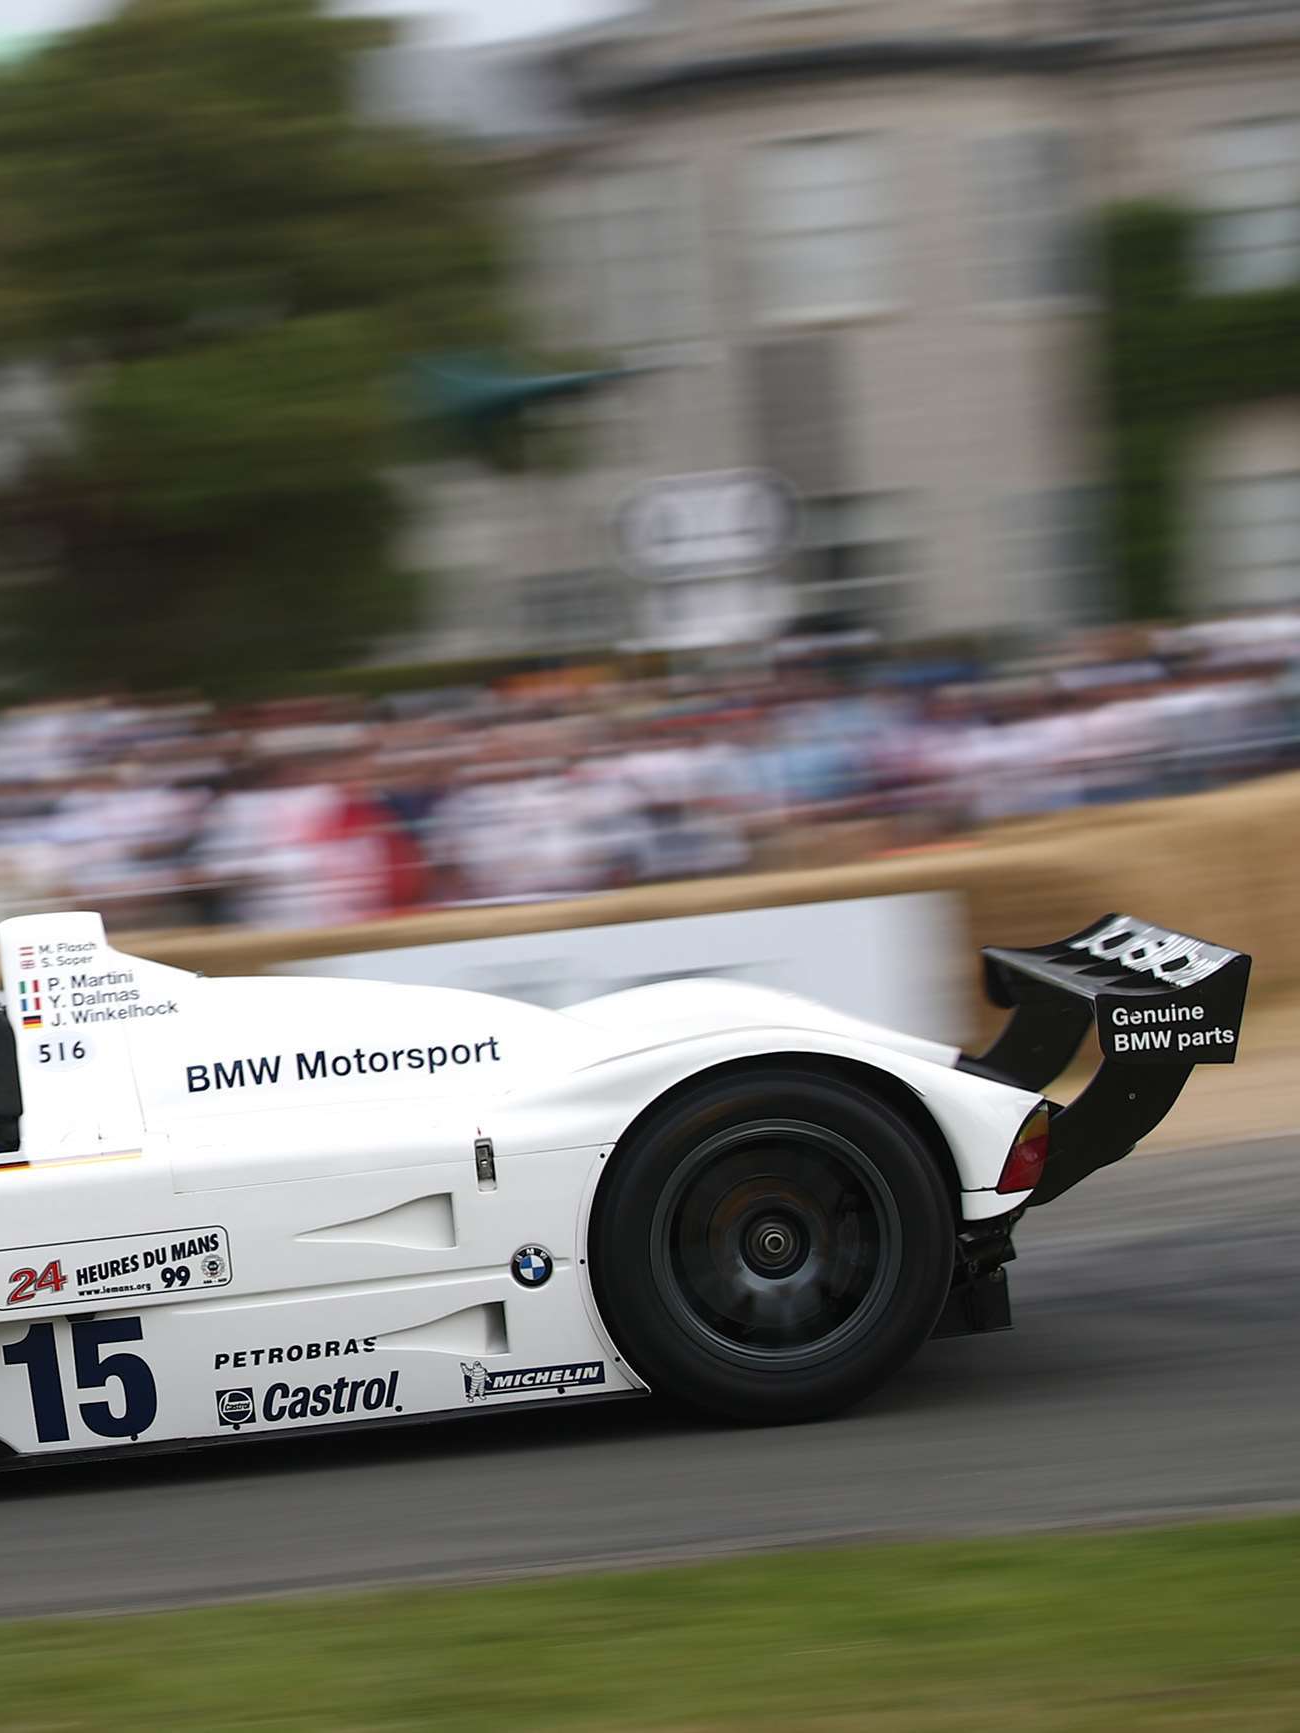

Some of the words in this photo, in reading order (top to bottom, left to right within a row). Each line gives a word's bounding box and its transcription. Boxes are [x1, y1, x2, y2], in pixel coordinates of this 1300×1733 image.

[41, 957, 54, 968] S.
[48, 977, 66, 991] P.
[71, 969, 134, 989] Martini
[48, 995, 66, 1009] Y.
[72, 987, 140, 1007] Dalmas
[51, 1013, 67, 1027] J.
[72, 1000, 178, 1024] Winkelhock
[1111, 1003, 1204, 1026] Genuine
[1113, 1030, 1172, 1052] BMW
[1178, 1027, 1235, 1051] parts
[38, 1041, 86, 1063] 516
[186, 1055, 282, 1093] BMW
[296, 1036, 500, 1080] Motorsport
[6, 1259, 68, 1306] 24
[76, 1254, 139, 1286] HEURES
[143, 1246, 167, 1269] DU
[171, 1233, 218, 1261] MANS
[160, 1265, 191, 1288] 99
[78, 1283, 151, 1296] www.lemans.org
[214, 1335, 377, 1370] PETROBRAS
[2, 1316, 159, 1445] 15
[492, 1366, 600, 1389] MICHELIN
[262, 1370, 400, 1422] Castrol
